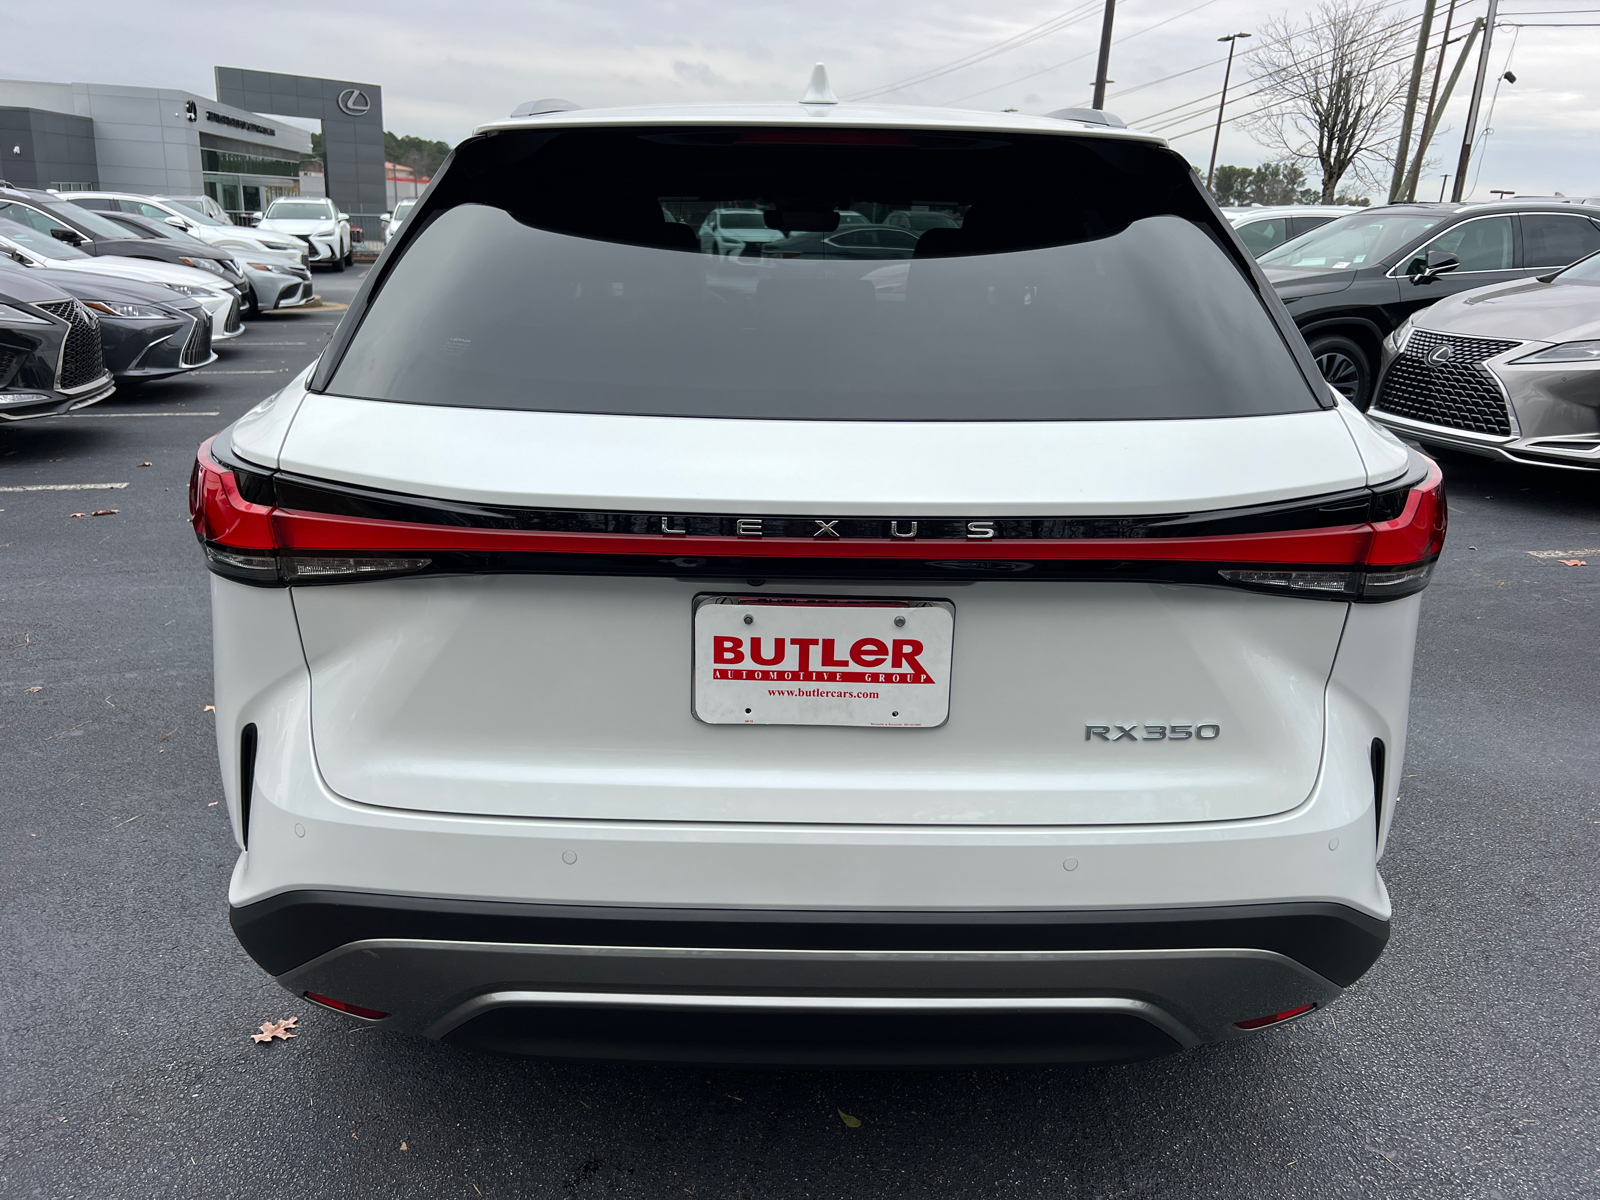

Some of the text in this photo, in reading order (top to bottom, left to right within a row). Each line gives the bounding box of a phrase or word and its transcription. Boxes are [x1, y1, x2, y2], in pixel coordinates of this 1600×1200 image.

[661, 517, 995, 538] LEXUS
[714, 670, 927, 683] AUTOMOTIVE GROUP
[767, 687, 880, 699] www.butlercars.com
